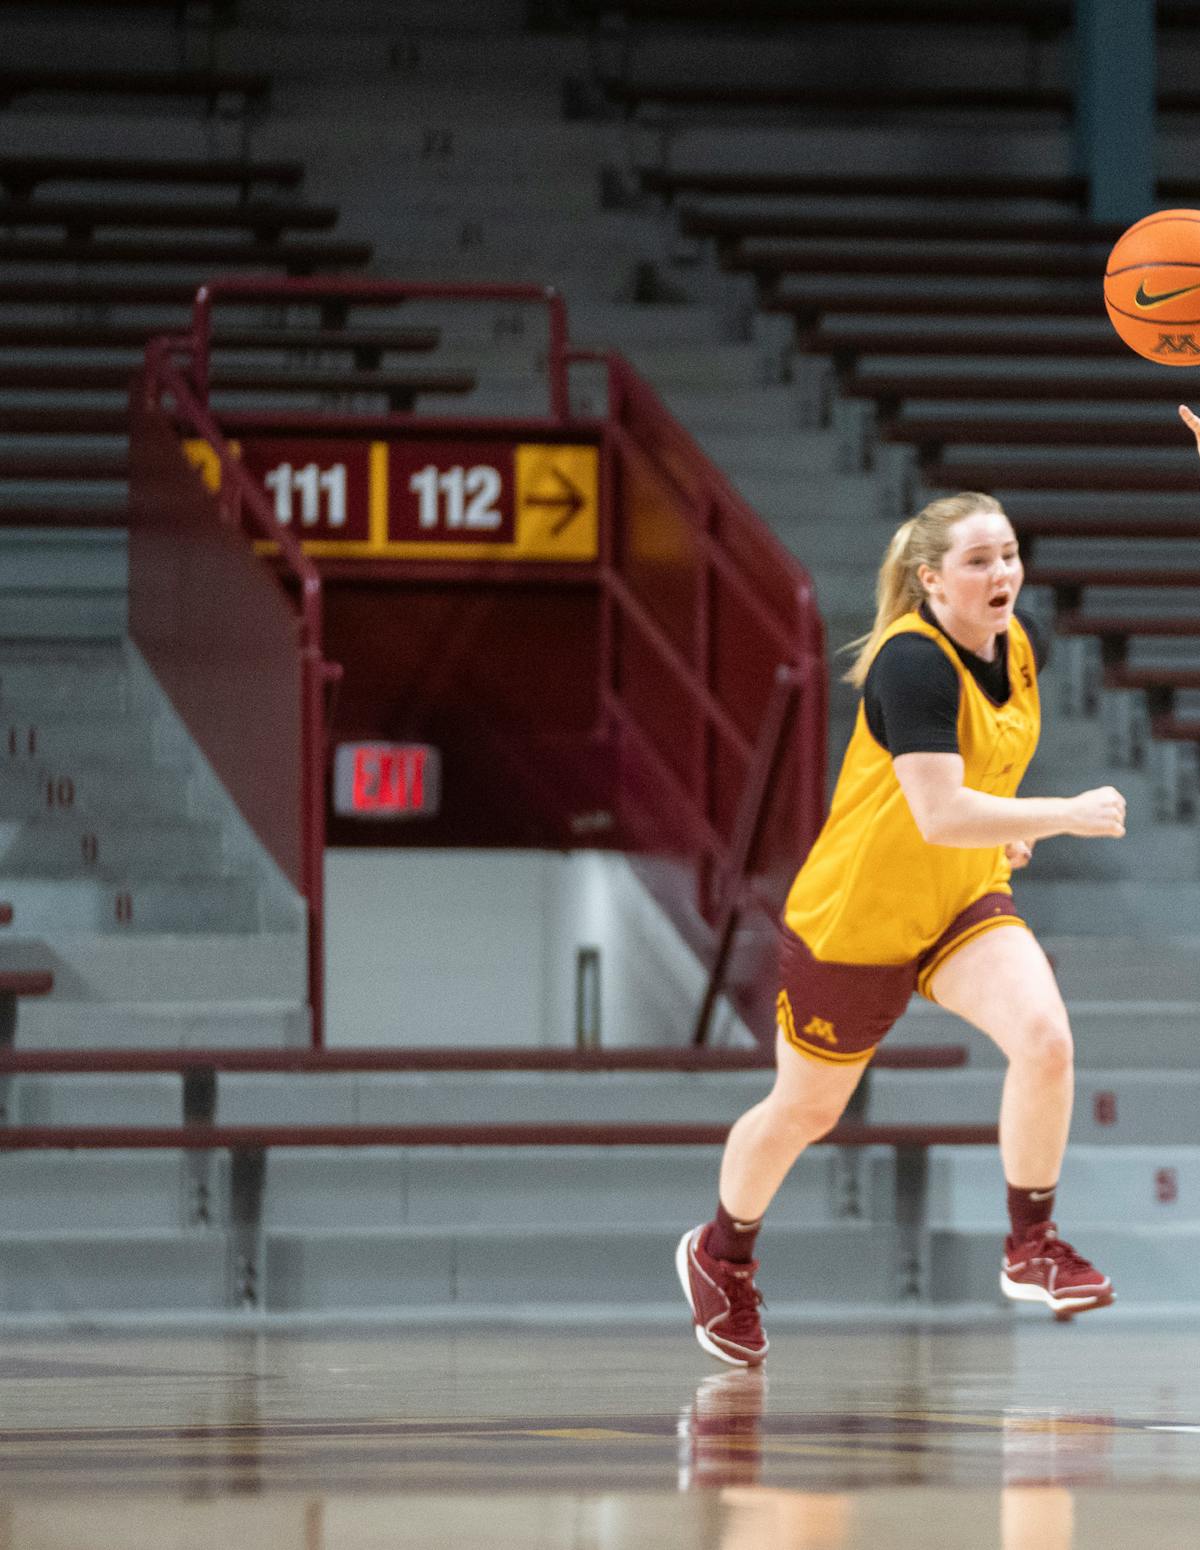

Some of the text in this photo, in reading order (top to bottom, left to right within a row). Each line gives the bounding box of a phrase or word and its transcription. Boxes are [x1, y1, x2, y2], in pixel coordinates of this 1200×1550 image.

[264, 462, 347, 528] 111
[409, 464, 502, 530] 112
[352, 747, 426, 812] EXIT
[803, 1016, 838, 1044] M
